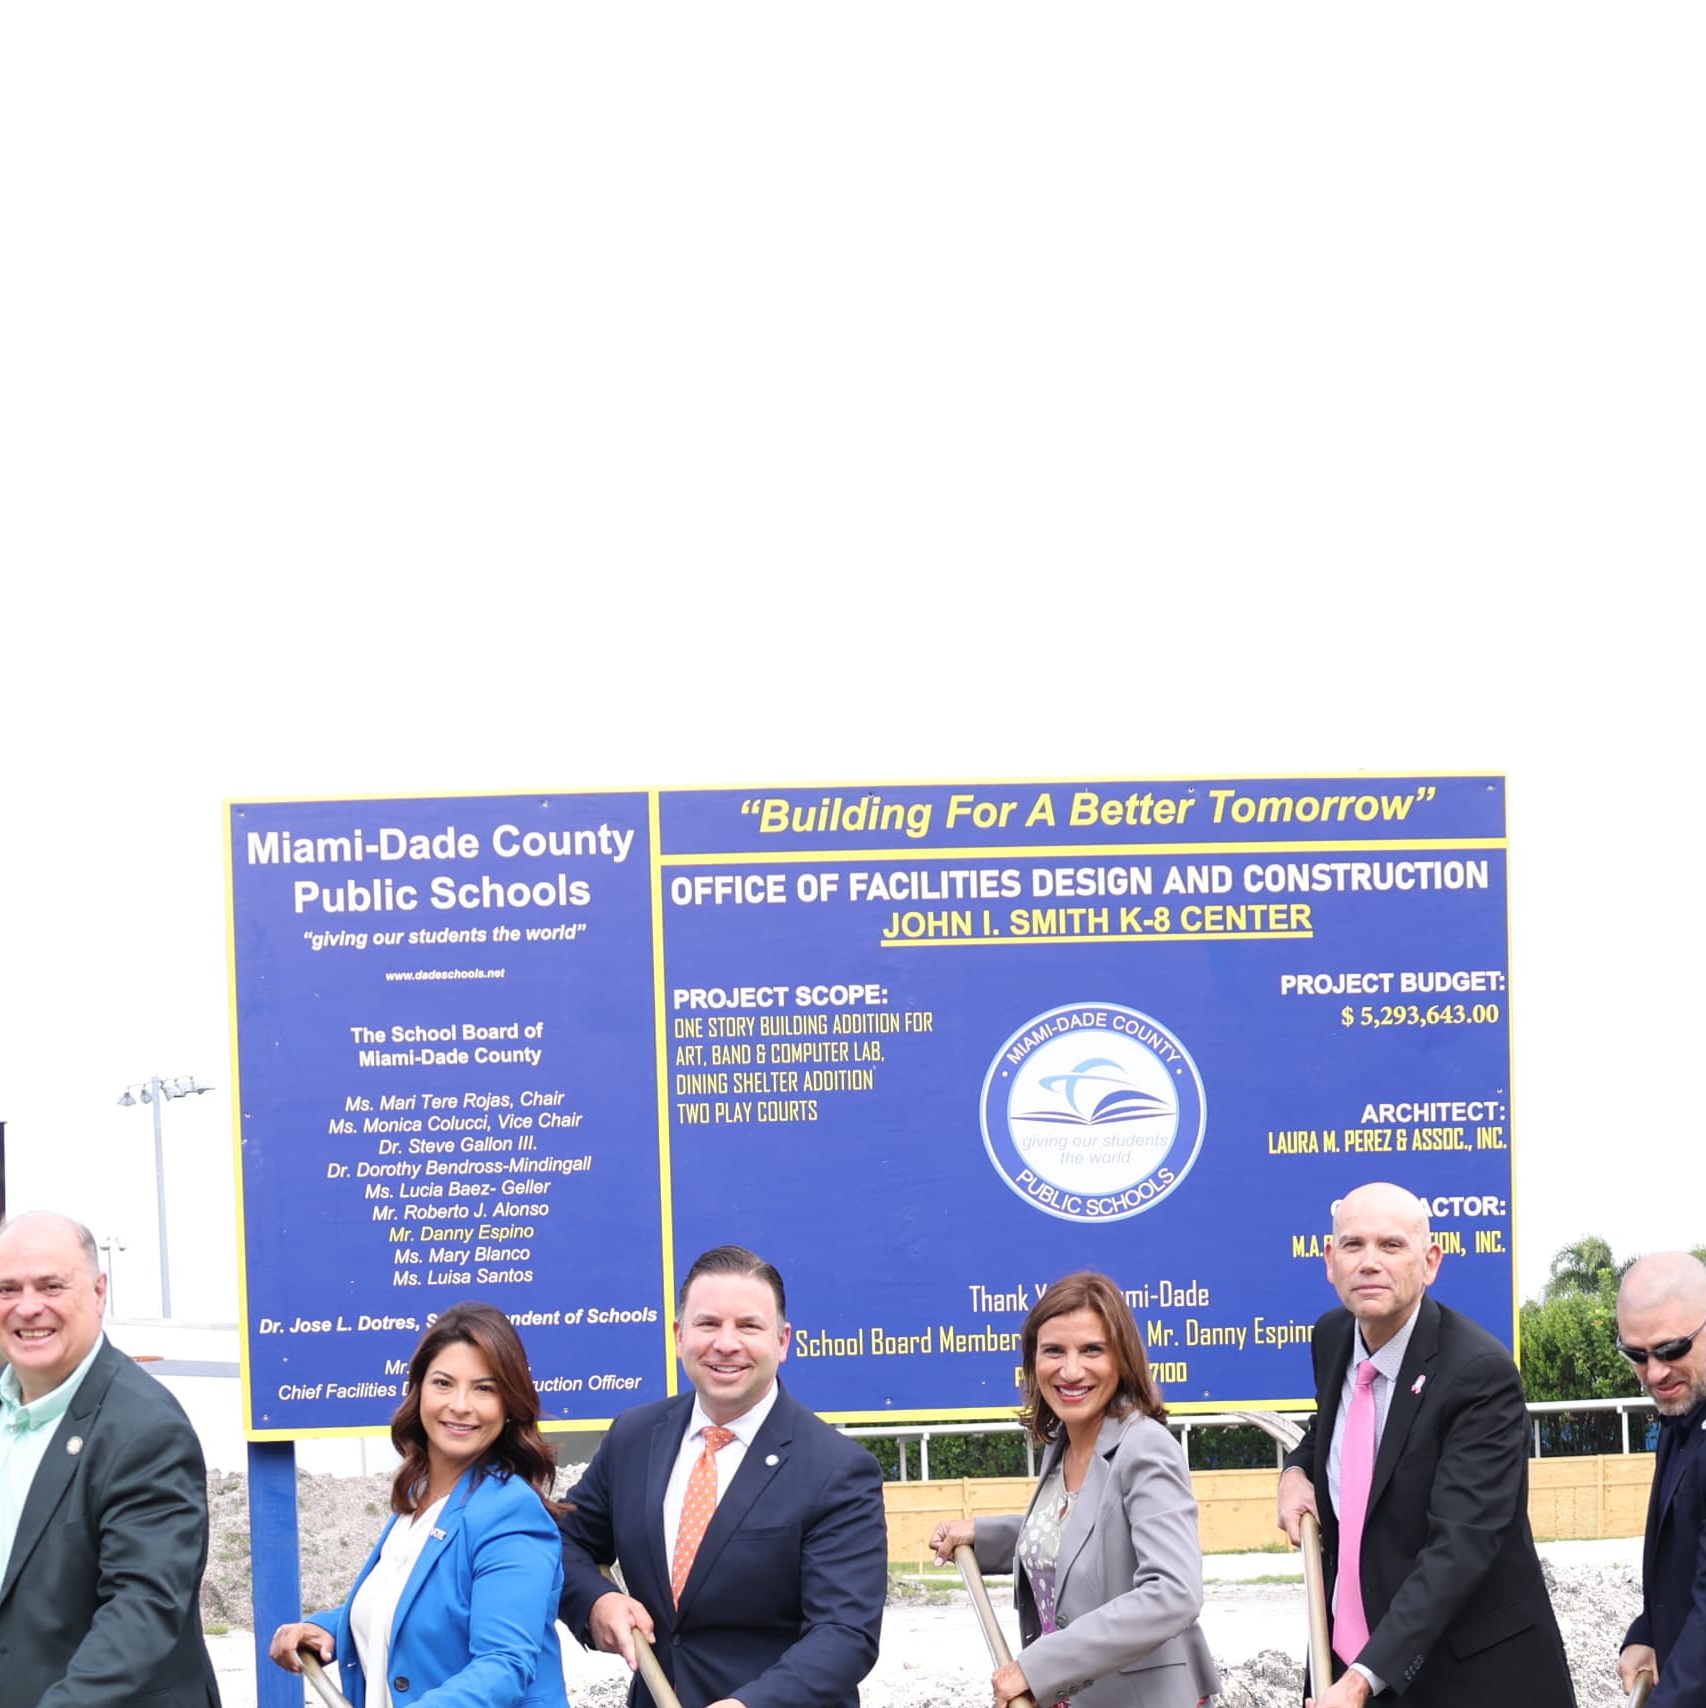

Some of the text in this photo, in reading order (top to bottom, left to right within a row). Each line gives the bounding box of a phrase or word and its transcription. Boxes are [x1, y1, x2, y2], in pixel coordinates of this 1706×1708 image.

[740, 786, 1436, 839] “Building For A Better Tomorrow”
[247, 823, 635, 865] Miami-Dade County
[294, 873, 591, 914] Public Schools
[671, 860, 1489, 906] OFFICE OF FACILITIES DESIGN AND CONSTRUCTION
[882, 903, 1313, 939] JOHN I. SMITH K-8 CENTER
[303, 923, 587, 951] “giving our students the world”
[385, 968, 506, 982] www.dadeschools.net
[1280, 970, 1505, 995] PROJECT BUDGET:
[673, 984, 888, 1010] PROJECT SCOPE:
[674, 1011, 933, 1039] ONE STORY BUILDING ADDITION FOR
[1341, 1003, 1499, 1029] $ 5,293,643.00
[350, 1021, 544, 1044] The School Board of
[1006, 1012, 1182, 1065] MIAMI-DADE COUNTY
[358, 1046, 542, 1068] Miami-Dade County
[675, 1045, 707, 1067] ART,
[711, 1044, 751, 1066] BAND
[756, 1043, 767, 1064] &
[771, 1041, 849, 1064] COMPUTER
[676, 1069, 873, 1095] DINING SHELTER ADDITION
[344, 1090, 566, 1112] Ms. Mari Tere Rojas, Chair
[676, 1099, 818, 1124] TWO PLAY COURTS
[1360, 1101, 1506, 1124] ARCHITECT:
[328, 1111, 583, 1135] Ms. Monica Colucci, Vice Chair
[378, 1135, 537, 1155] Dr. Steve Gallon III.
[1022, 1133, 1168, 1150] giving our students
[1268, 1126, 1508, 1155] LAURA M. PEREZ & ASSOC., INC.
[327, 1155, 592, 1180] Dr. Dorothy Bendross-Mindingall
[1060, 1150, 1131, 1164] the world
[364, 1178, 552, 1199] Ms. Lucia Baez- Geller
[1016, 1167, 1175, 1216] PUBLIC SCHOOLS
[372, 1201, 550, 1221] Mr. Roberto J. Alonso
[388, 1223, 535, 1244] Mr. Danny Espino
[1475, 1230, 1506, 1253] INC.
[394, 1246, 531, 1266] Ms. Mary Blanco
[393, 1267, 534, 1286] Ms. Luisa Santos
[968, 1284, 1029, 1313] Thank
[1121, 1279, 1209, 1309] mi-Dade
[259, 1318, 284, 1334] Dr.
[289, 1317, 332, 1333] Jose
[336, 1316, 352, 1332] L.
[357, 1315, 420, 1332] Dotres,
[564, 1308, 584, 1325] of
[586, 1306, 658, 1324] Schools
[795, 1328, 864, 1358] School
[871, 1326, 932, 1355] Board
[1147, 1319, 1179, 1347] Mr.
[1186, 1318, 1247, 1351] Danny
[278, 1383, 323, 1401] Chief
[325, 1382, 397, 1399] Facilities
[588, 1374, 643, 1391] Officer
